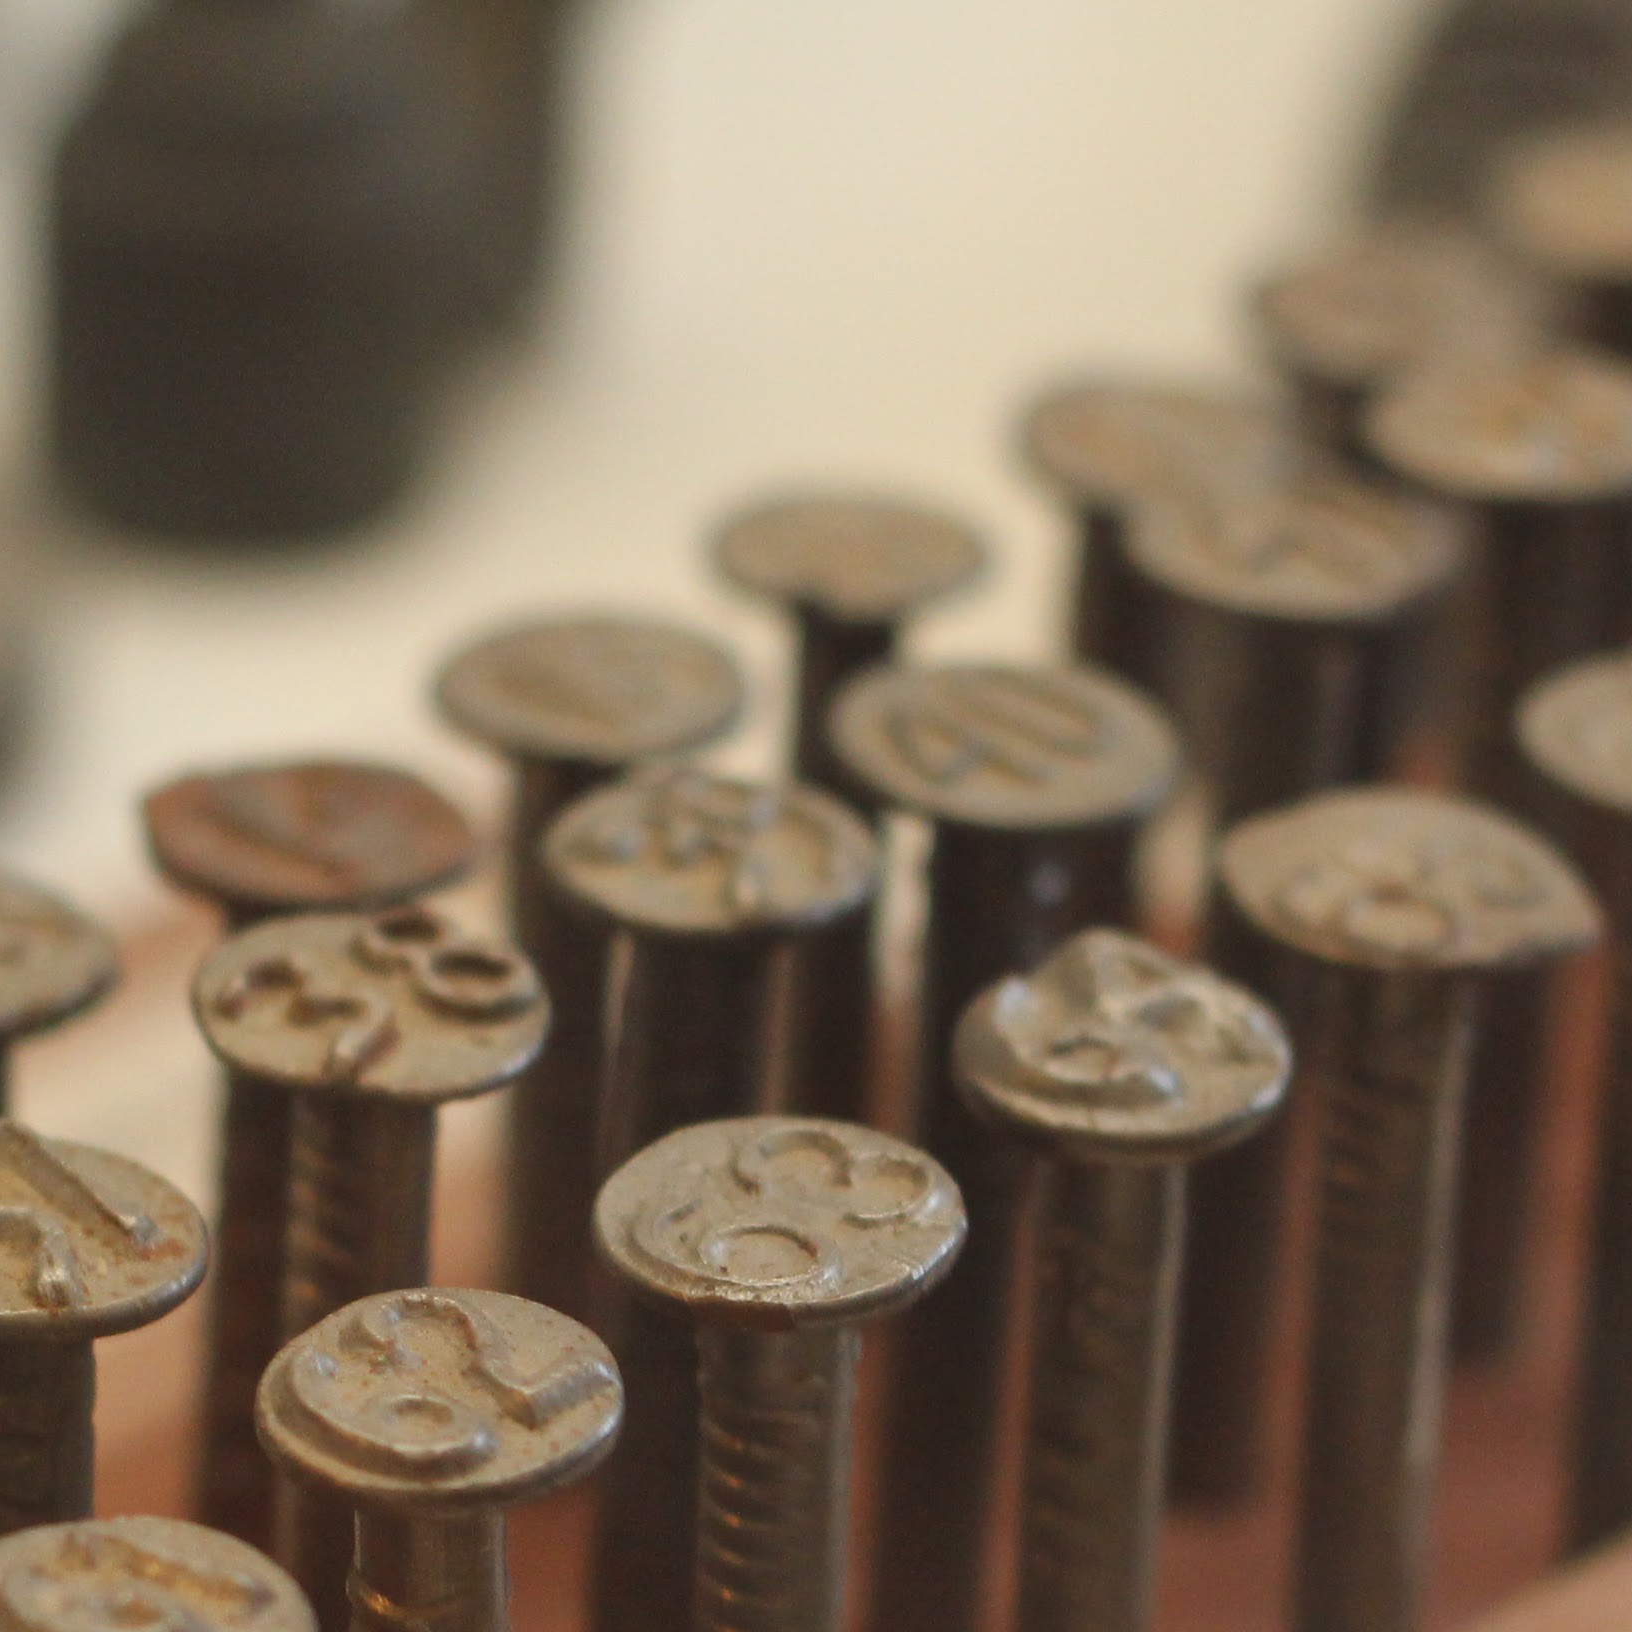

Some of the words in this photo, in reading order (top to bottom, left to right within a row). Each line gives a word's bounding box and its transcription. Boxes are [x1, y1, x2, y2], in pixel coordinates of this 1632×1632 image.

[212, 908, 527, 1085] 38
[625, 1125, 949, 1305] 63
[272, 1295, 615, 1485] 62
